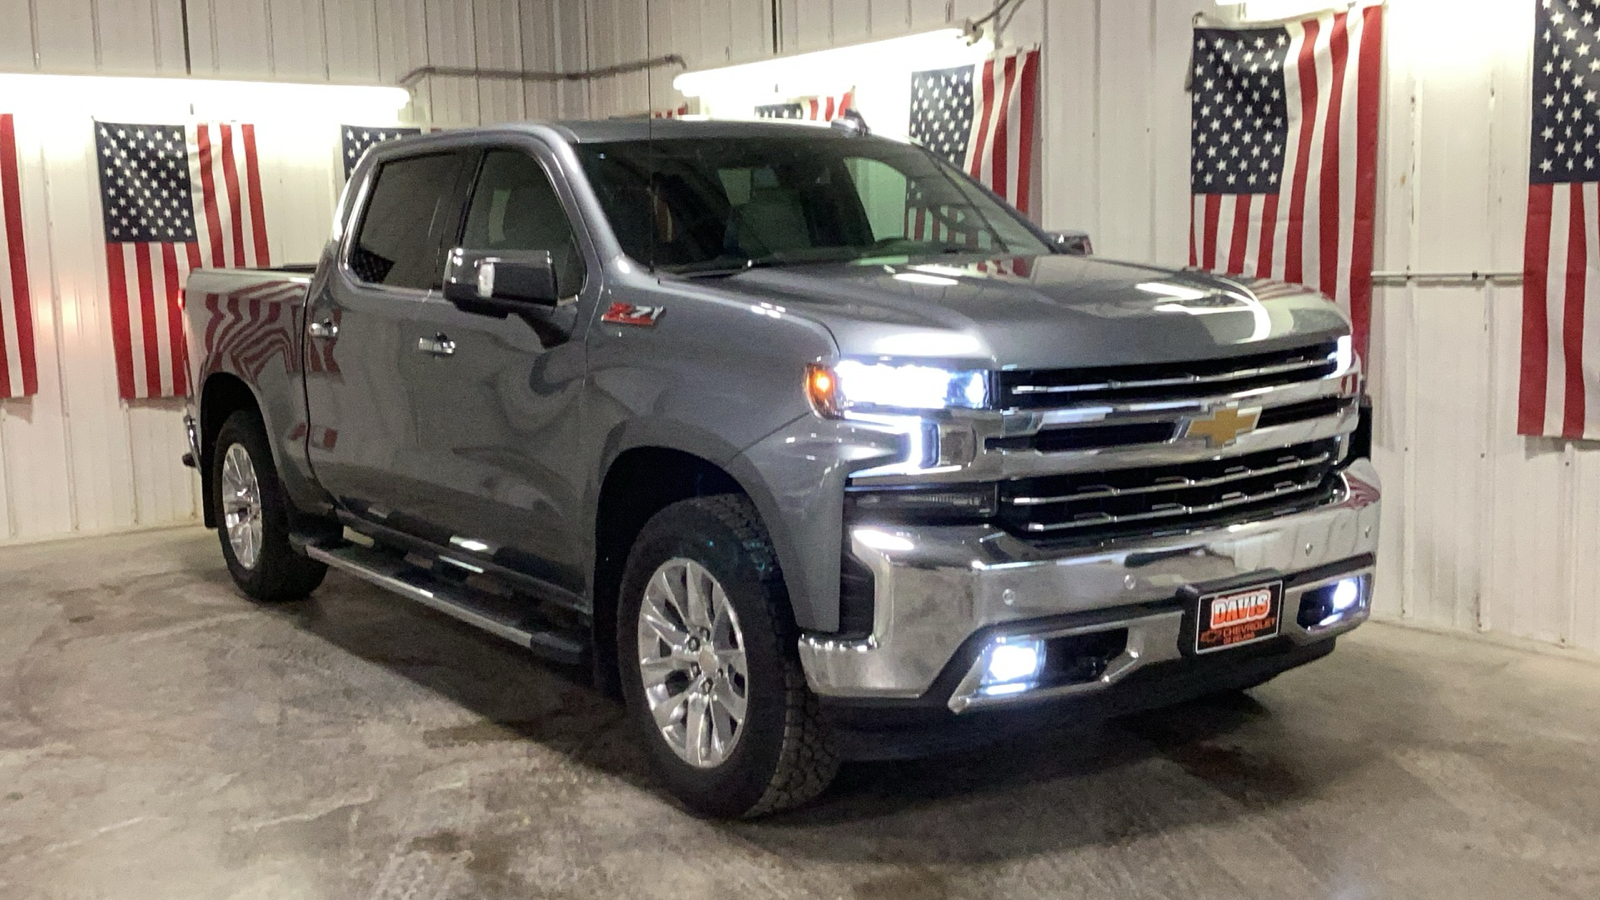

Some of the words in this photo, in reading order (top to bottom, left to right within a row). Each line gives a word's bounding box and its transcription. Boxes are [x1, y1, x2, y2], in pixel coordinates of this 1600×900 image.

[601, 302, 664, 325] Z71
[1211, 591, 1270, 626] DAVIS
[1223, 617, 1276, 637] CHEVROLET
